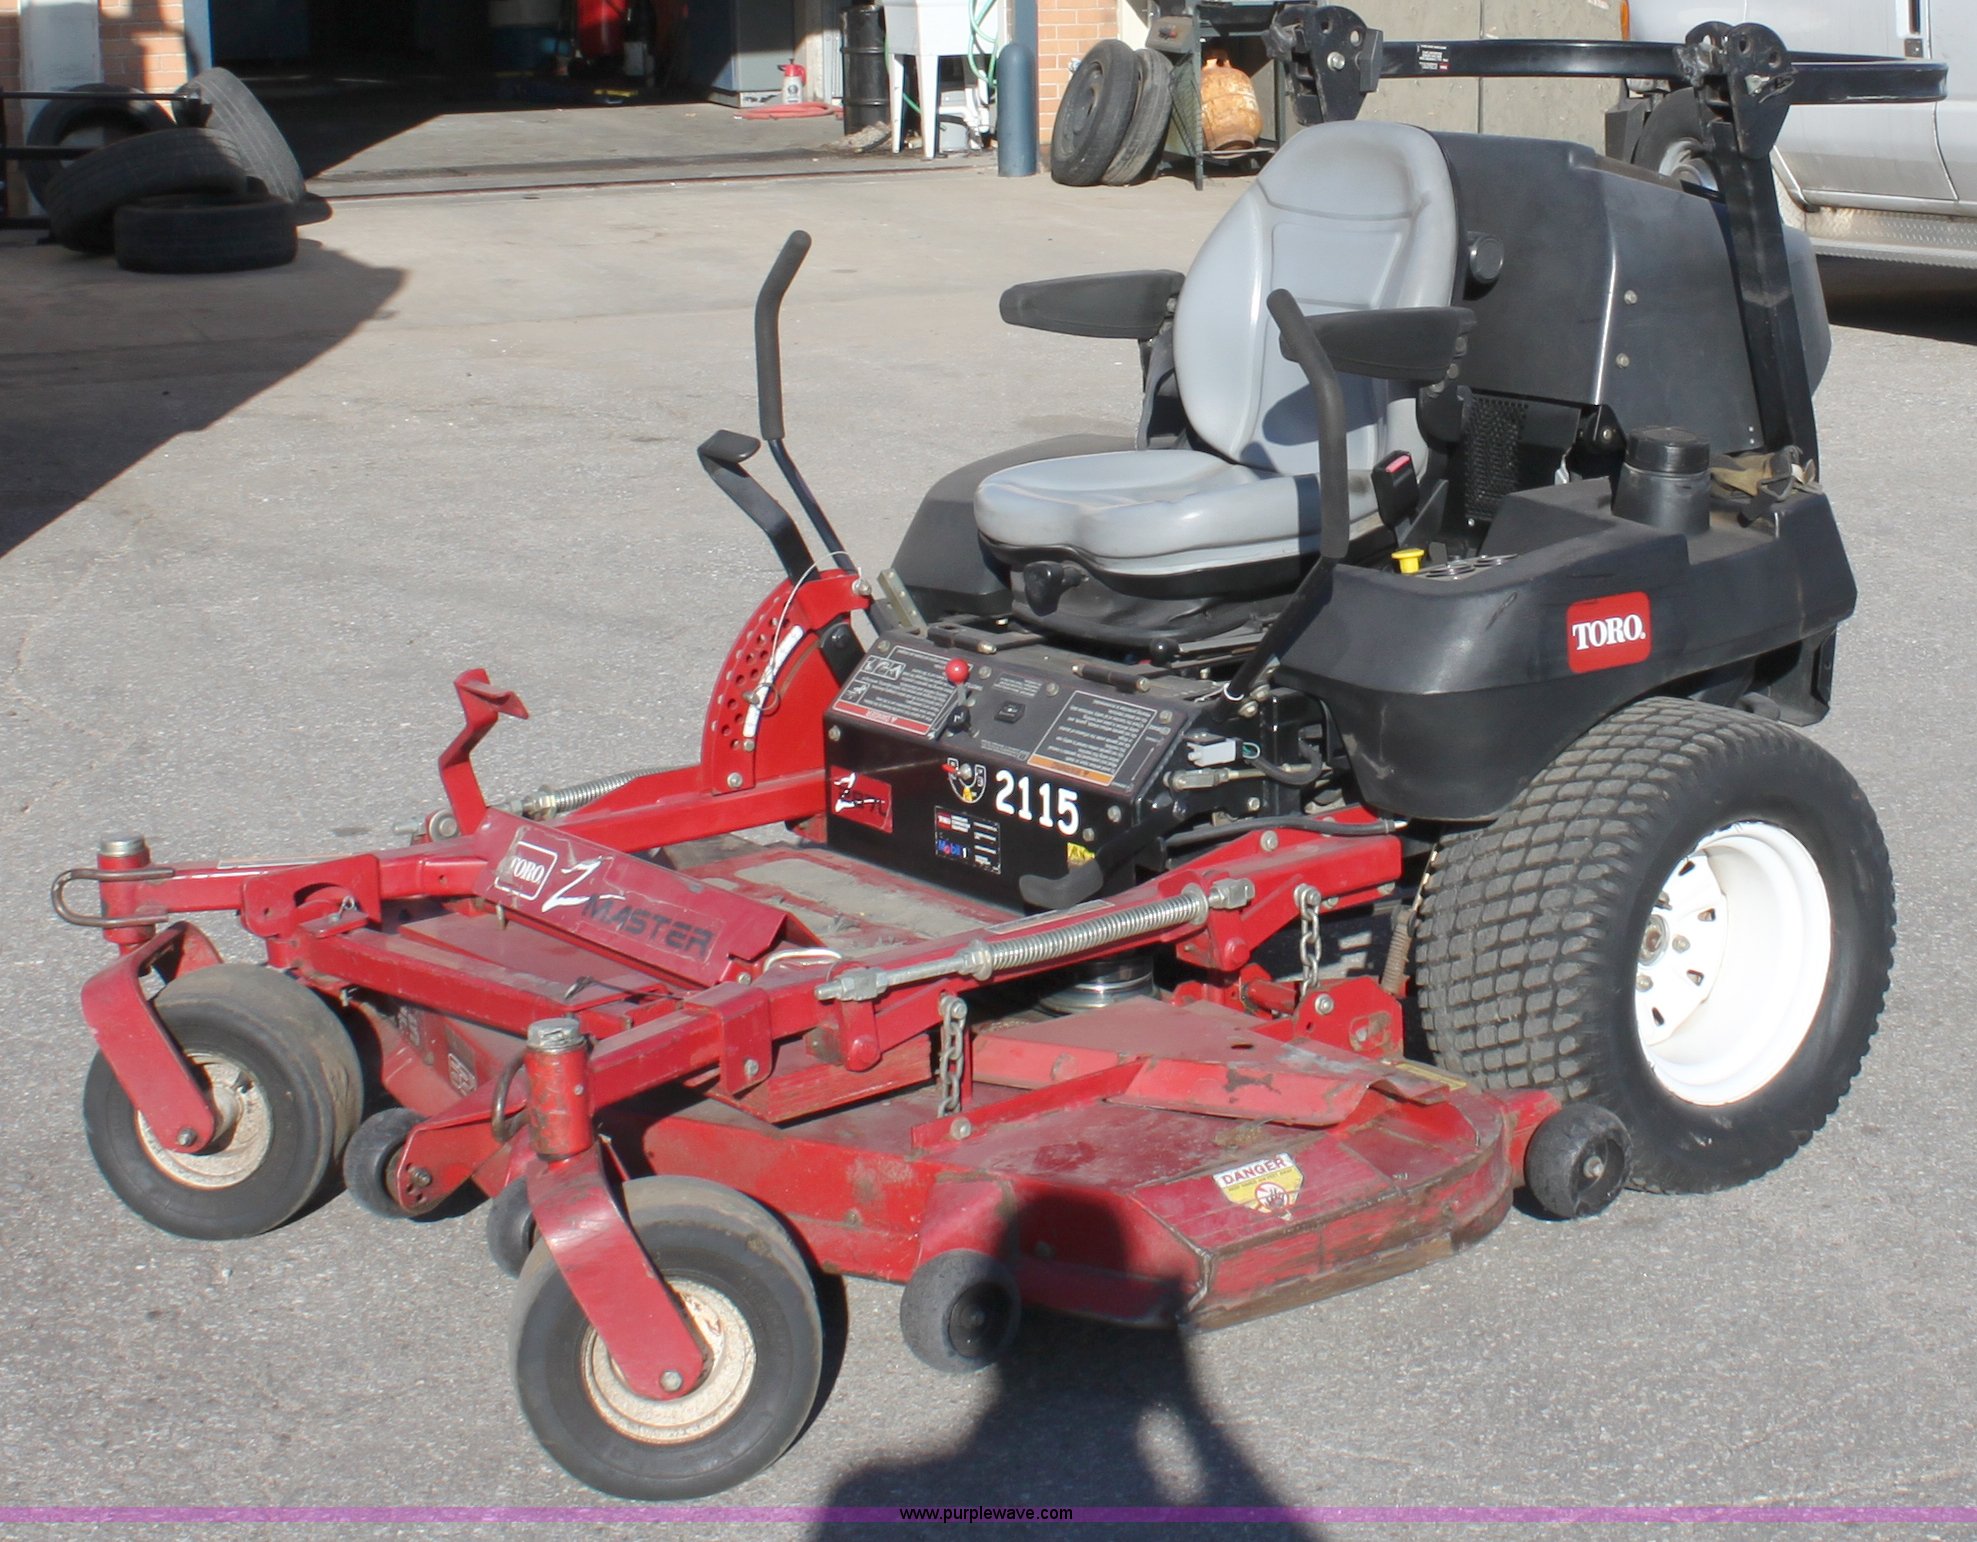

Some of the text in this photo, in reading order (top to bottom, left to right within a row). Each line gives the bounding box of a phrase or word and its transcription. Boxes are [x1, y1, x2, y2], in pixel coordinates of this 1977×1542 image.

[995, 769, 1080, 836] 2115
[541, 855, 625, 912] Z
[583, 897, 714, 953] MASTER
[1223, 1158, 1286, 1185] DANGER
